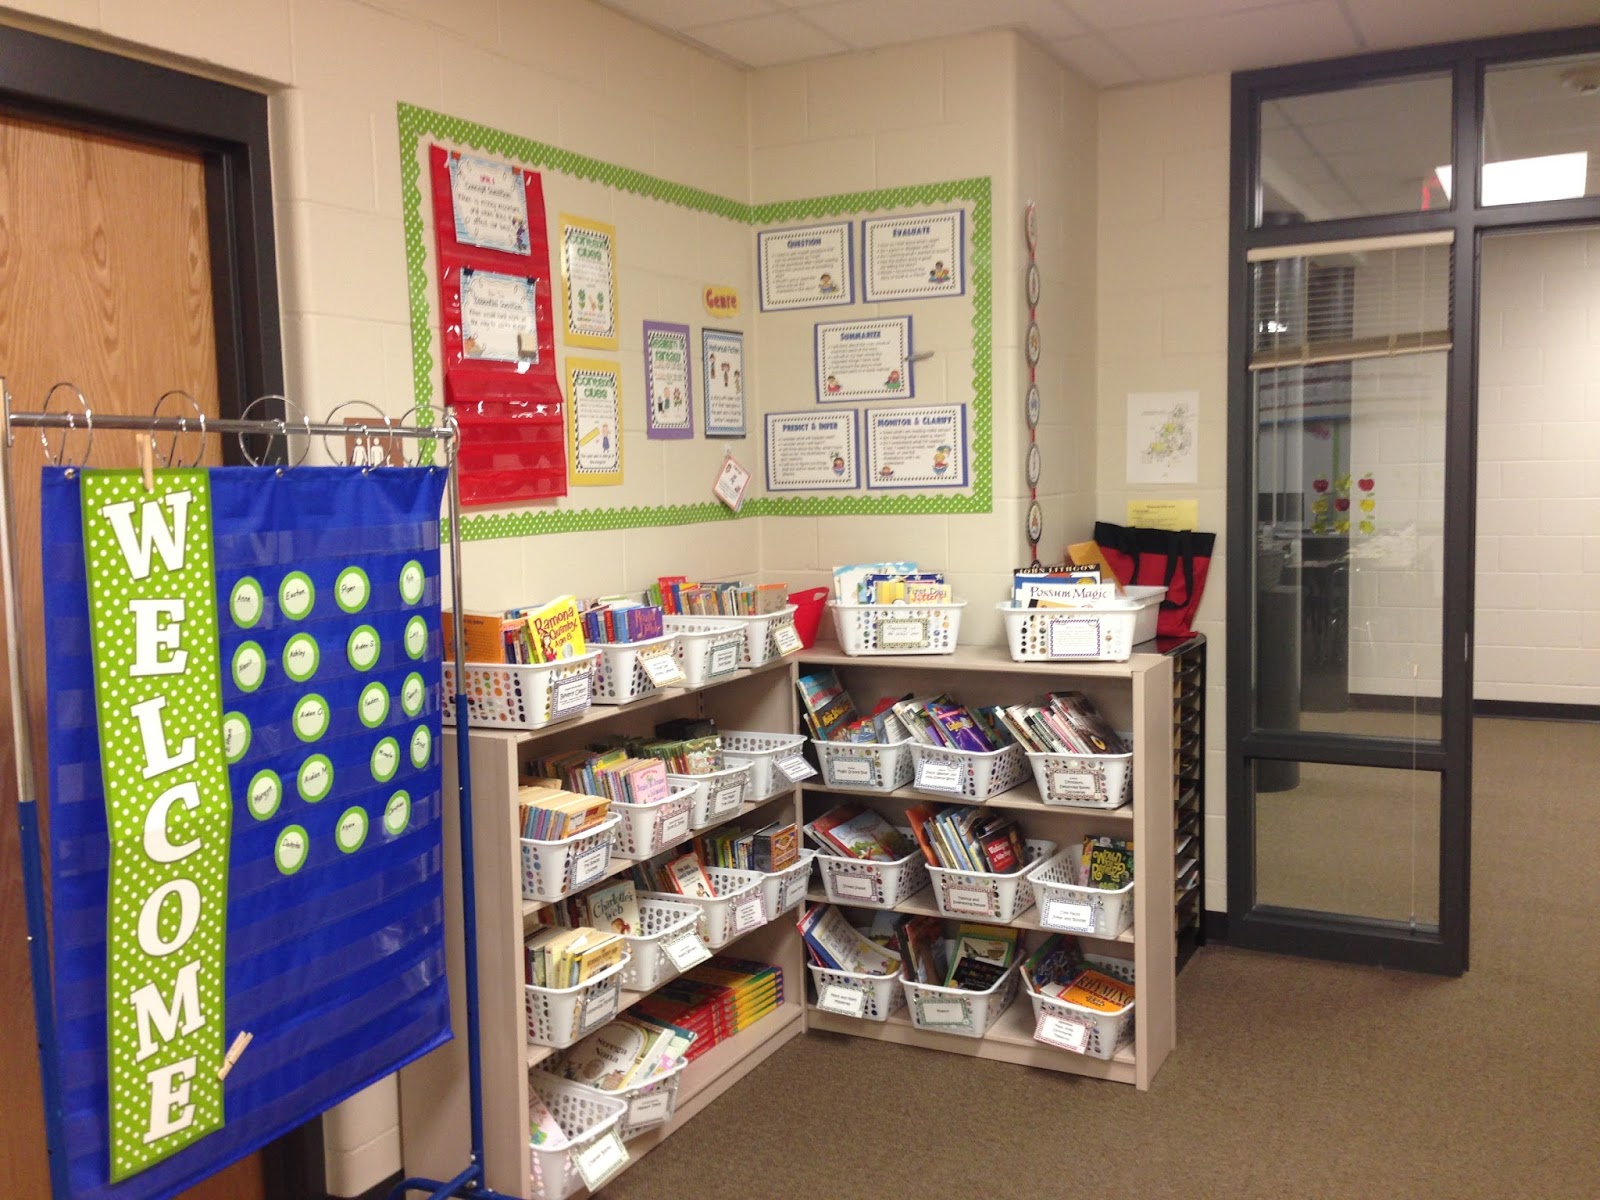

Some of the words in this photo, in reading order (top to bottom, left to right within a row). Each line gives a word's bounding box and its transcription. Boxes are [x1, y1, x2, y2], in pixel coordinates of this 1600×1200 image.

[893, 226, 930, 237] EVALUATE
[787, 238, 822, 249] QUESTION
[706, 289, 738, 308] Genre
[840, 331, 881, 341] SUMMARIZE
[782, 424, 808, 432] PREDICT
[819, 422, 838, 431] INFER
[877, 418, 911, 427] MONITOR
[922, 416, 952, 425] CLARIFY
[1048, 564, 1097, 574] LITHGOW
[907, 586, 927, 596] First
[930, 586, 947, 597] Day
[1030, 586, 1070, 598] Possum
[1073, 588, 1107, 601] Magic
[533, 607, 574, 635] Ramona
[555, 637, 566, 648] Age
[566, 633, 572, 641] 8
[101, 489, 207, 1146] WELCOME
[593, 890, 634, 919] Charlotte's
